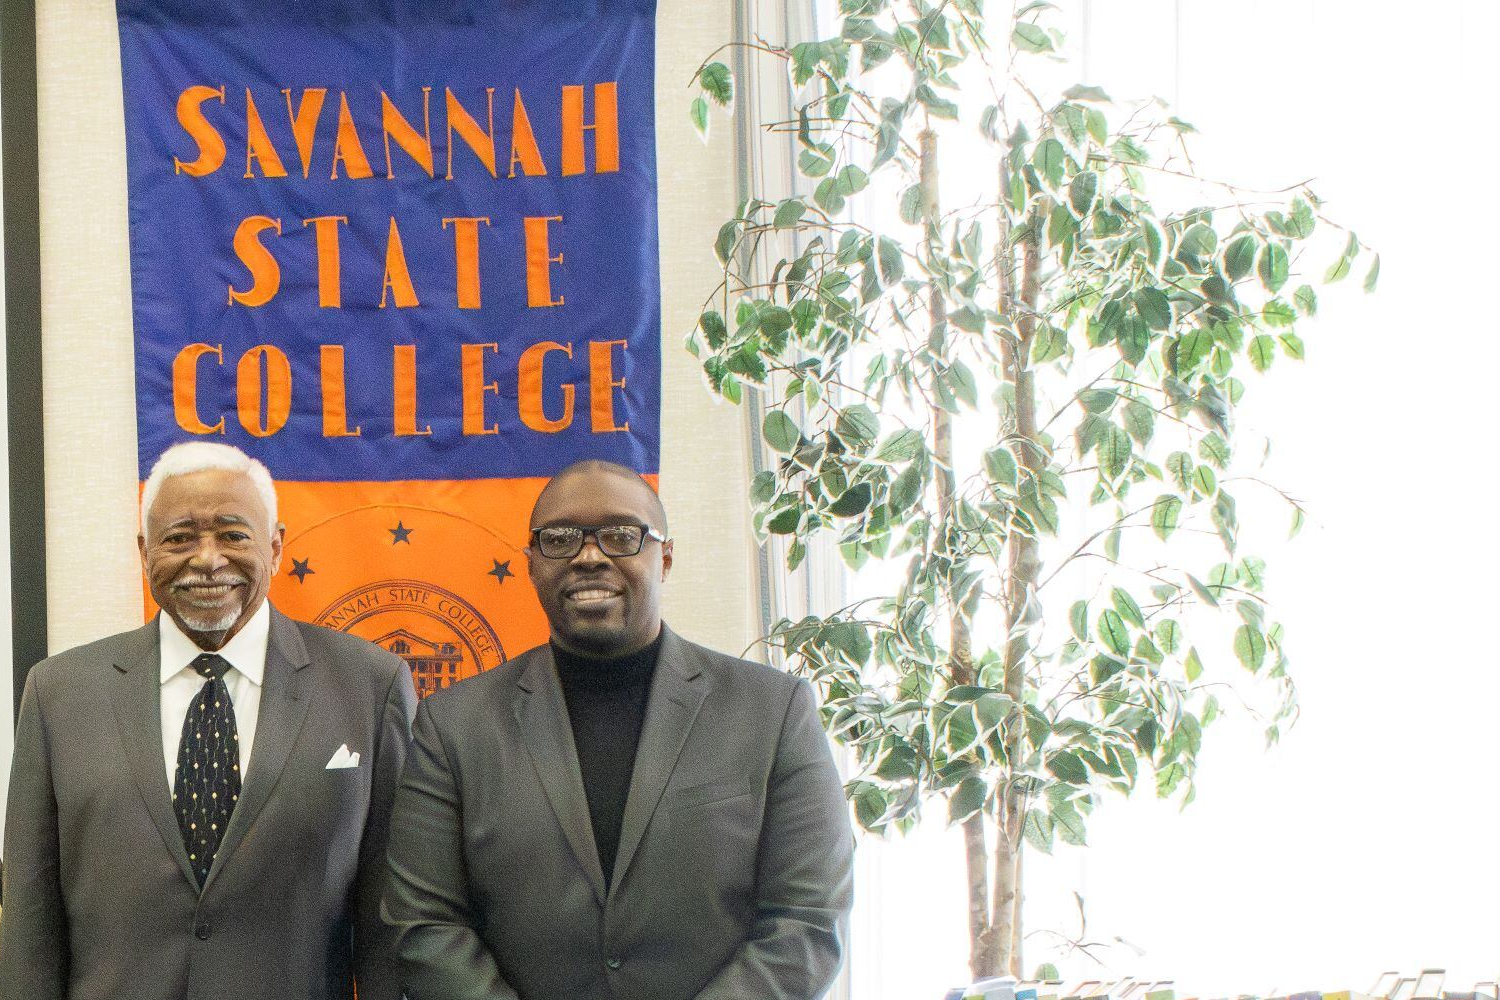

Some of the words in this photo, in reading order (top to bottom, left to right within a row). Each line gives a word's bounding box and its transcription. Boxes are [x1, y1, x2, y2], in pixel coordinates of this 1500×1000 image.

[174, 82, 620, 180] SAVANNAH
[228, 215, 566, 308] STATE
[172, 339, 630, 437] COLLEGE
[325, 594, 379, 629] ANNAH
[390, 589, 429, 604] STATE
[438, 600, 493, 656] COLLEGE
